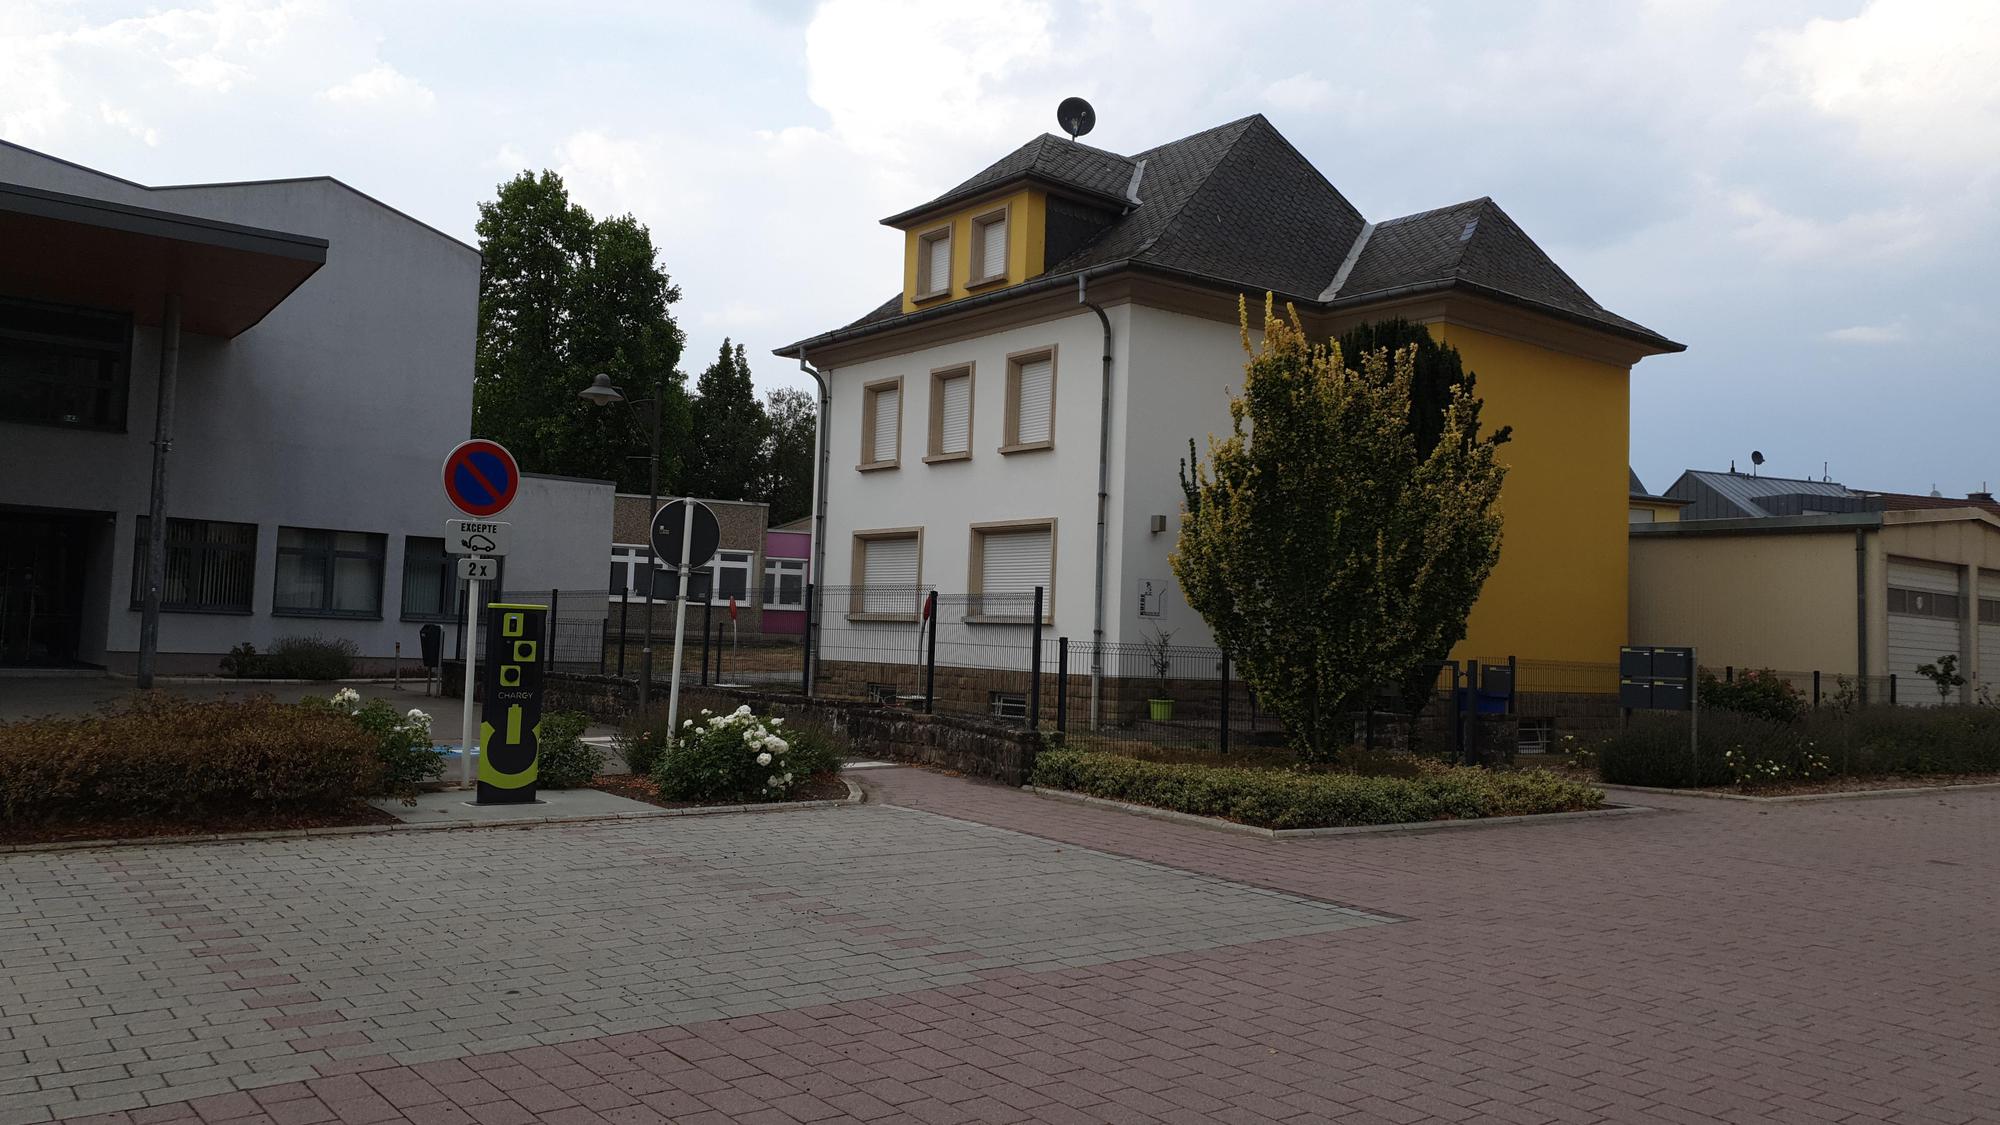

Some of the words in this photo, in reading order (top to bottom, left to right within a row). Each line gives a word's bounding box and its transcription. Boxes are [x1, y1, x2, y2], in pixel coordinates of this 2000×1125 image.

[461, 523, 497, 534] EXCEPTE
[468, 562, 477, 576] 2
[497, 691, 534, 699] CHARGY
